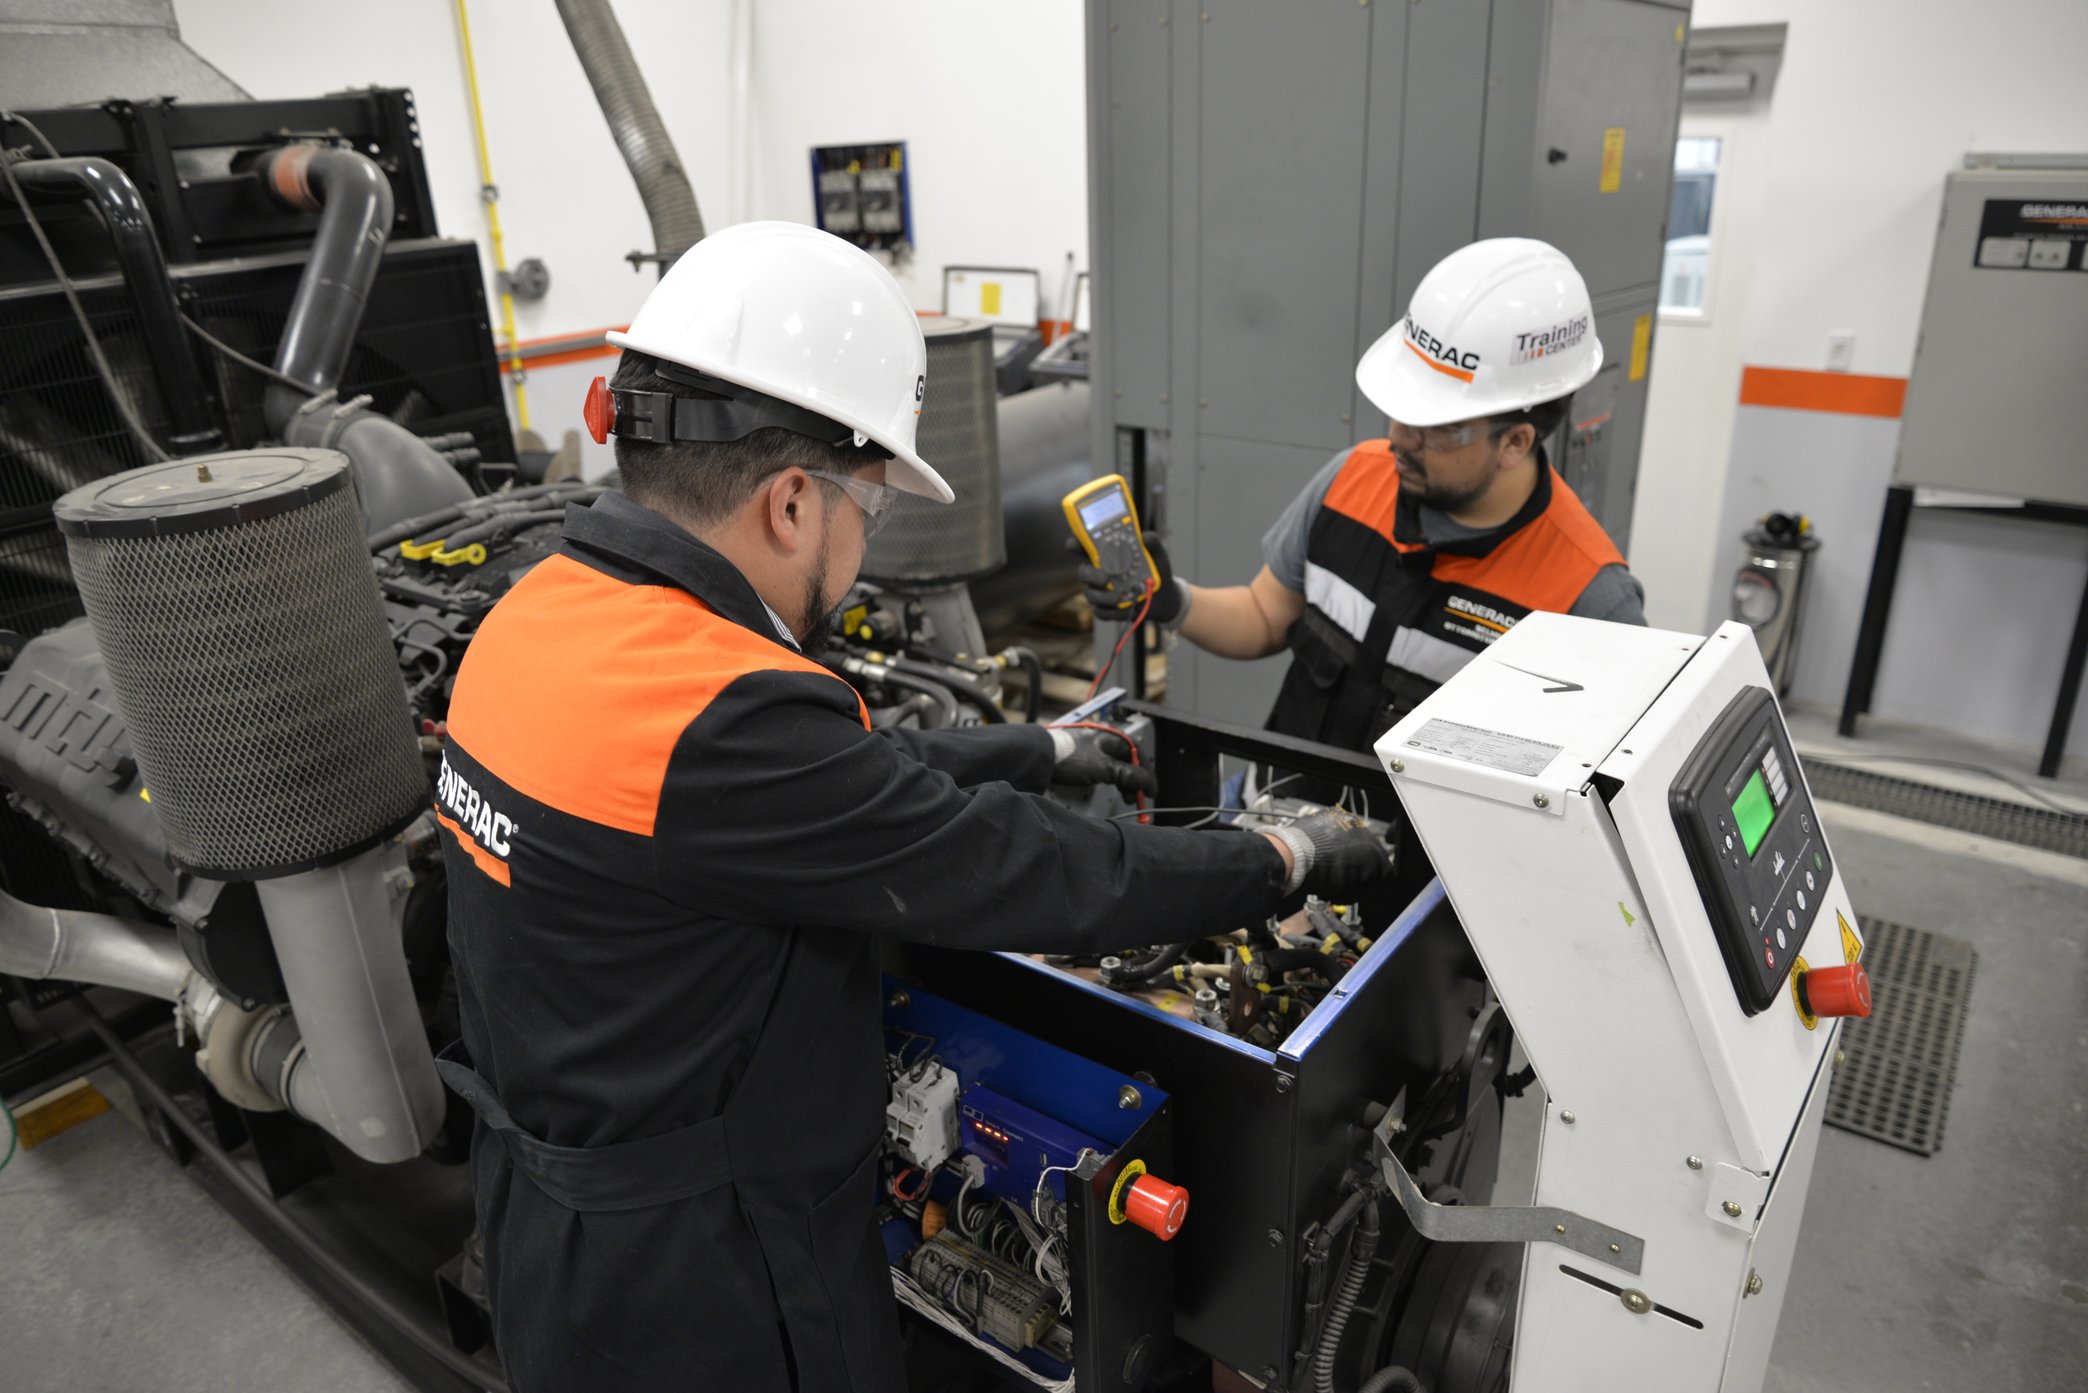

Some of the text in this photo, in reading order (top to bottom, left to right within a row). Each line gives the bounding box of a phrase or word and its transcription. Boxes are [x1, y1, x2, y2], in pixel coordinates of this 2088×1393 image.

[1518, 316, 1588, 351] Training
[1545, 334, 1582, 356] CENTER
[1447, 595, 1516, 629] GENERAC
